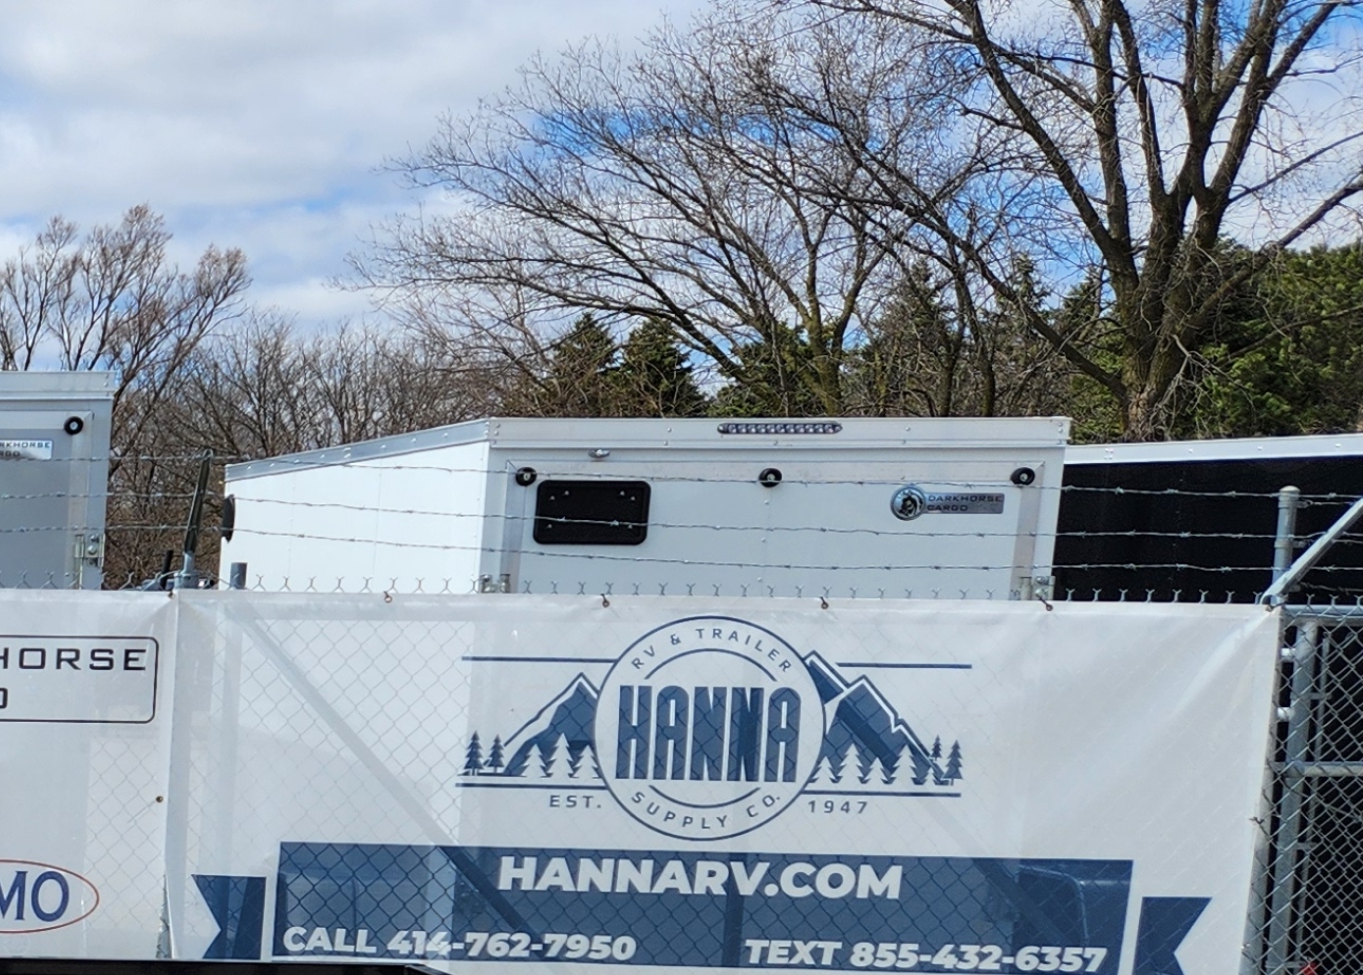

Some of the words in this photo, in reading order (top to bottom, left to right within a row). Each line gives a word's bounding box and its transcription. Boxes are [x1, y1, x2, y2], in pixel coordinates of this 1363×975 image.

[927, 494, 1003, 502] DARKHORSE
[927, 504, 969, 512] CARGO
[630, 645, 656, 670] RV
[670, 633, 681, 646] &
[695, 627, 792, 673] TRAILER
[615, 685, 802, 782] HANNA
[548, 795, 602, 809] EST.
[631, 791, 727, 829] SUPPLY
[746, 793, 781, 818] CO.
[808, 800, 868, 815] 1947
[497, 855, 903, 900] HANNARV.COM
[282, 926, 377, 954] CALL
[386, 929, 637, 961] 414-762-7950
[745, 939, 842, 967] TEXT
[850, 941, 1107, 973] 855-432-6357
